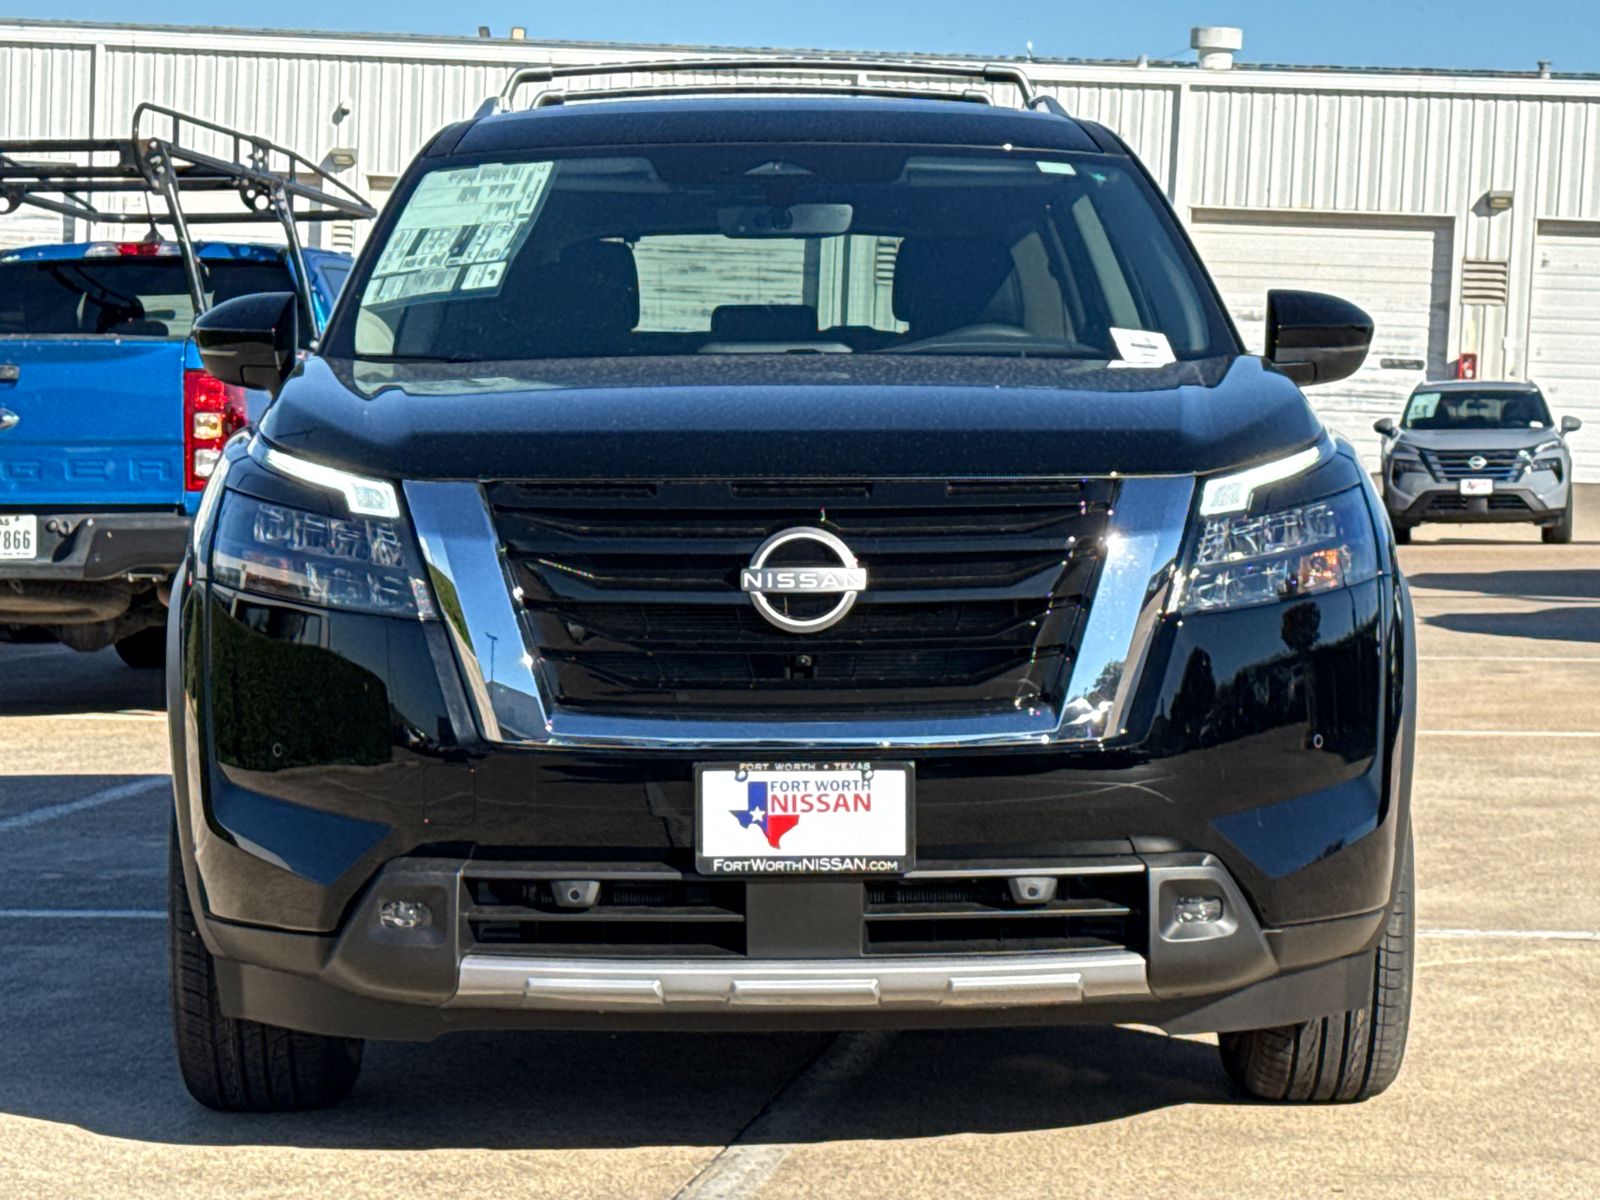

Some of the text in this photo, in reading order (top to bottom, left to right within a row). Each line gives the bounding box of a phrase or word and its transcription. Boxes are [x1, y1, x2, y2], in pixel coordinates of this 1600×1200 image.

[0, 530, 31, 550] 866
[743, 571, 863, 589] NISSAN
[739, 762, 871, 771] FORT WORTH TEXAS
[770, 779, 871, 792] FORT WORTH
[770, 793, 871, 813] NISSAN
